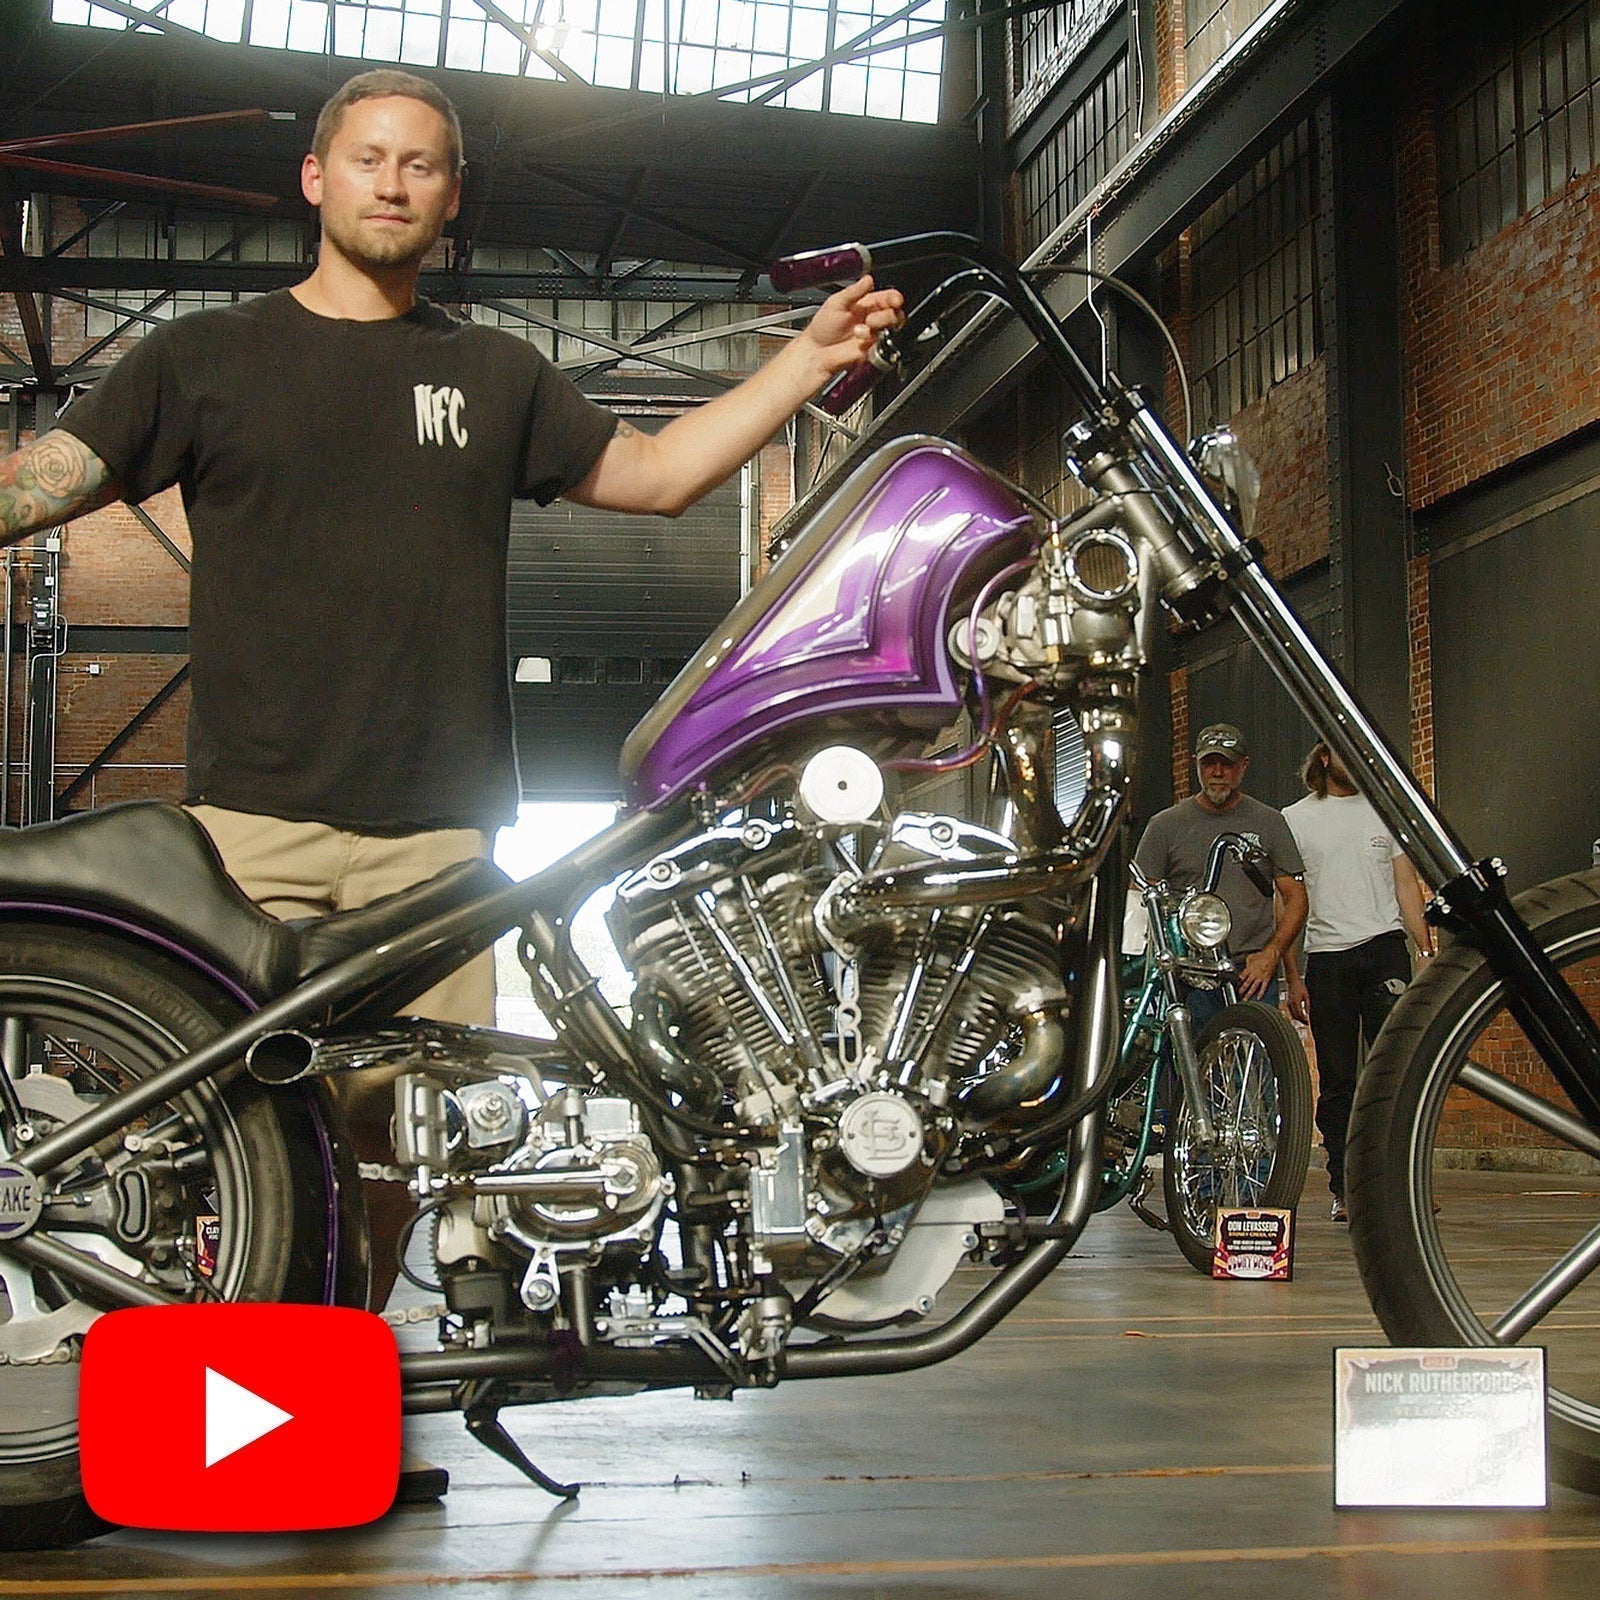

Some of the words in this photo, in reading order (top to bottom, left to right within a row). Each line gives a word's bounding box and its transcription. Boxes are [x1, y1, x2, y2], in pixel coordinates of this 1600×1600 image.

[413, 384, 468, 448] NFC
[0, 1185, 31, 1212] AKE
[1365, 1372, 1404, 1393] NICK
[1409, 1371, 1514, 1393] RUTHERFORD
